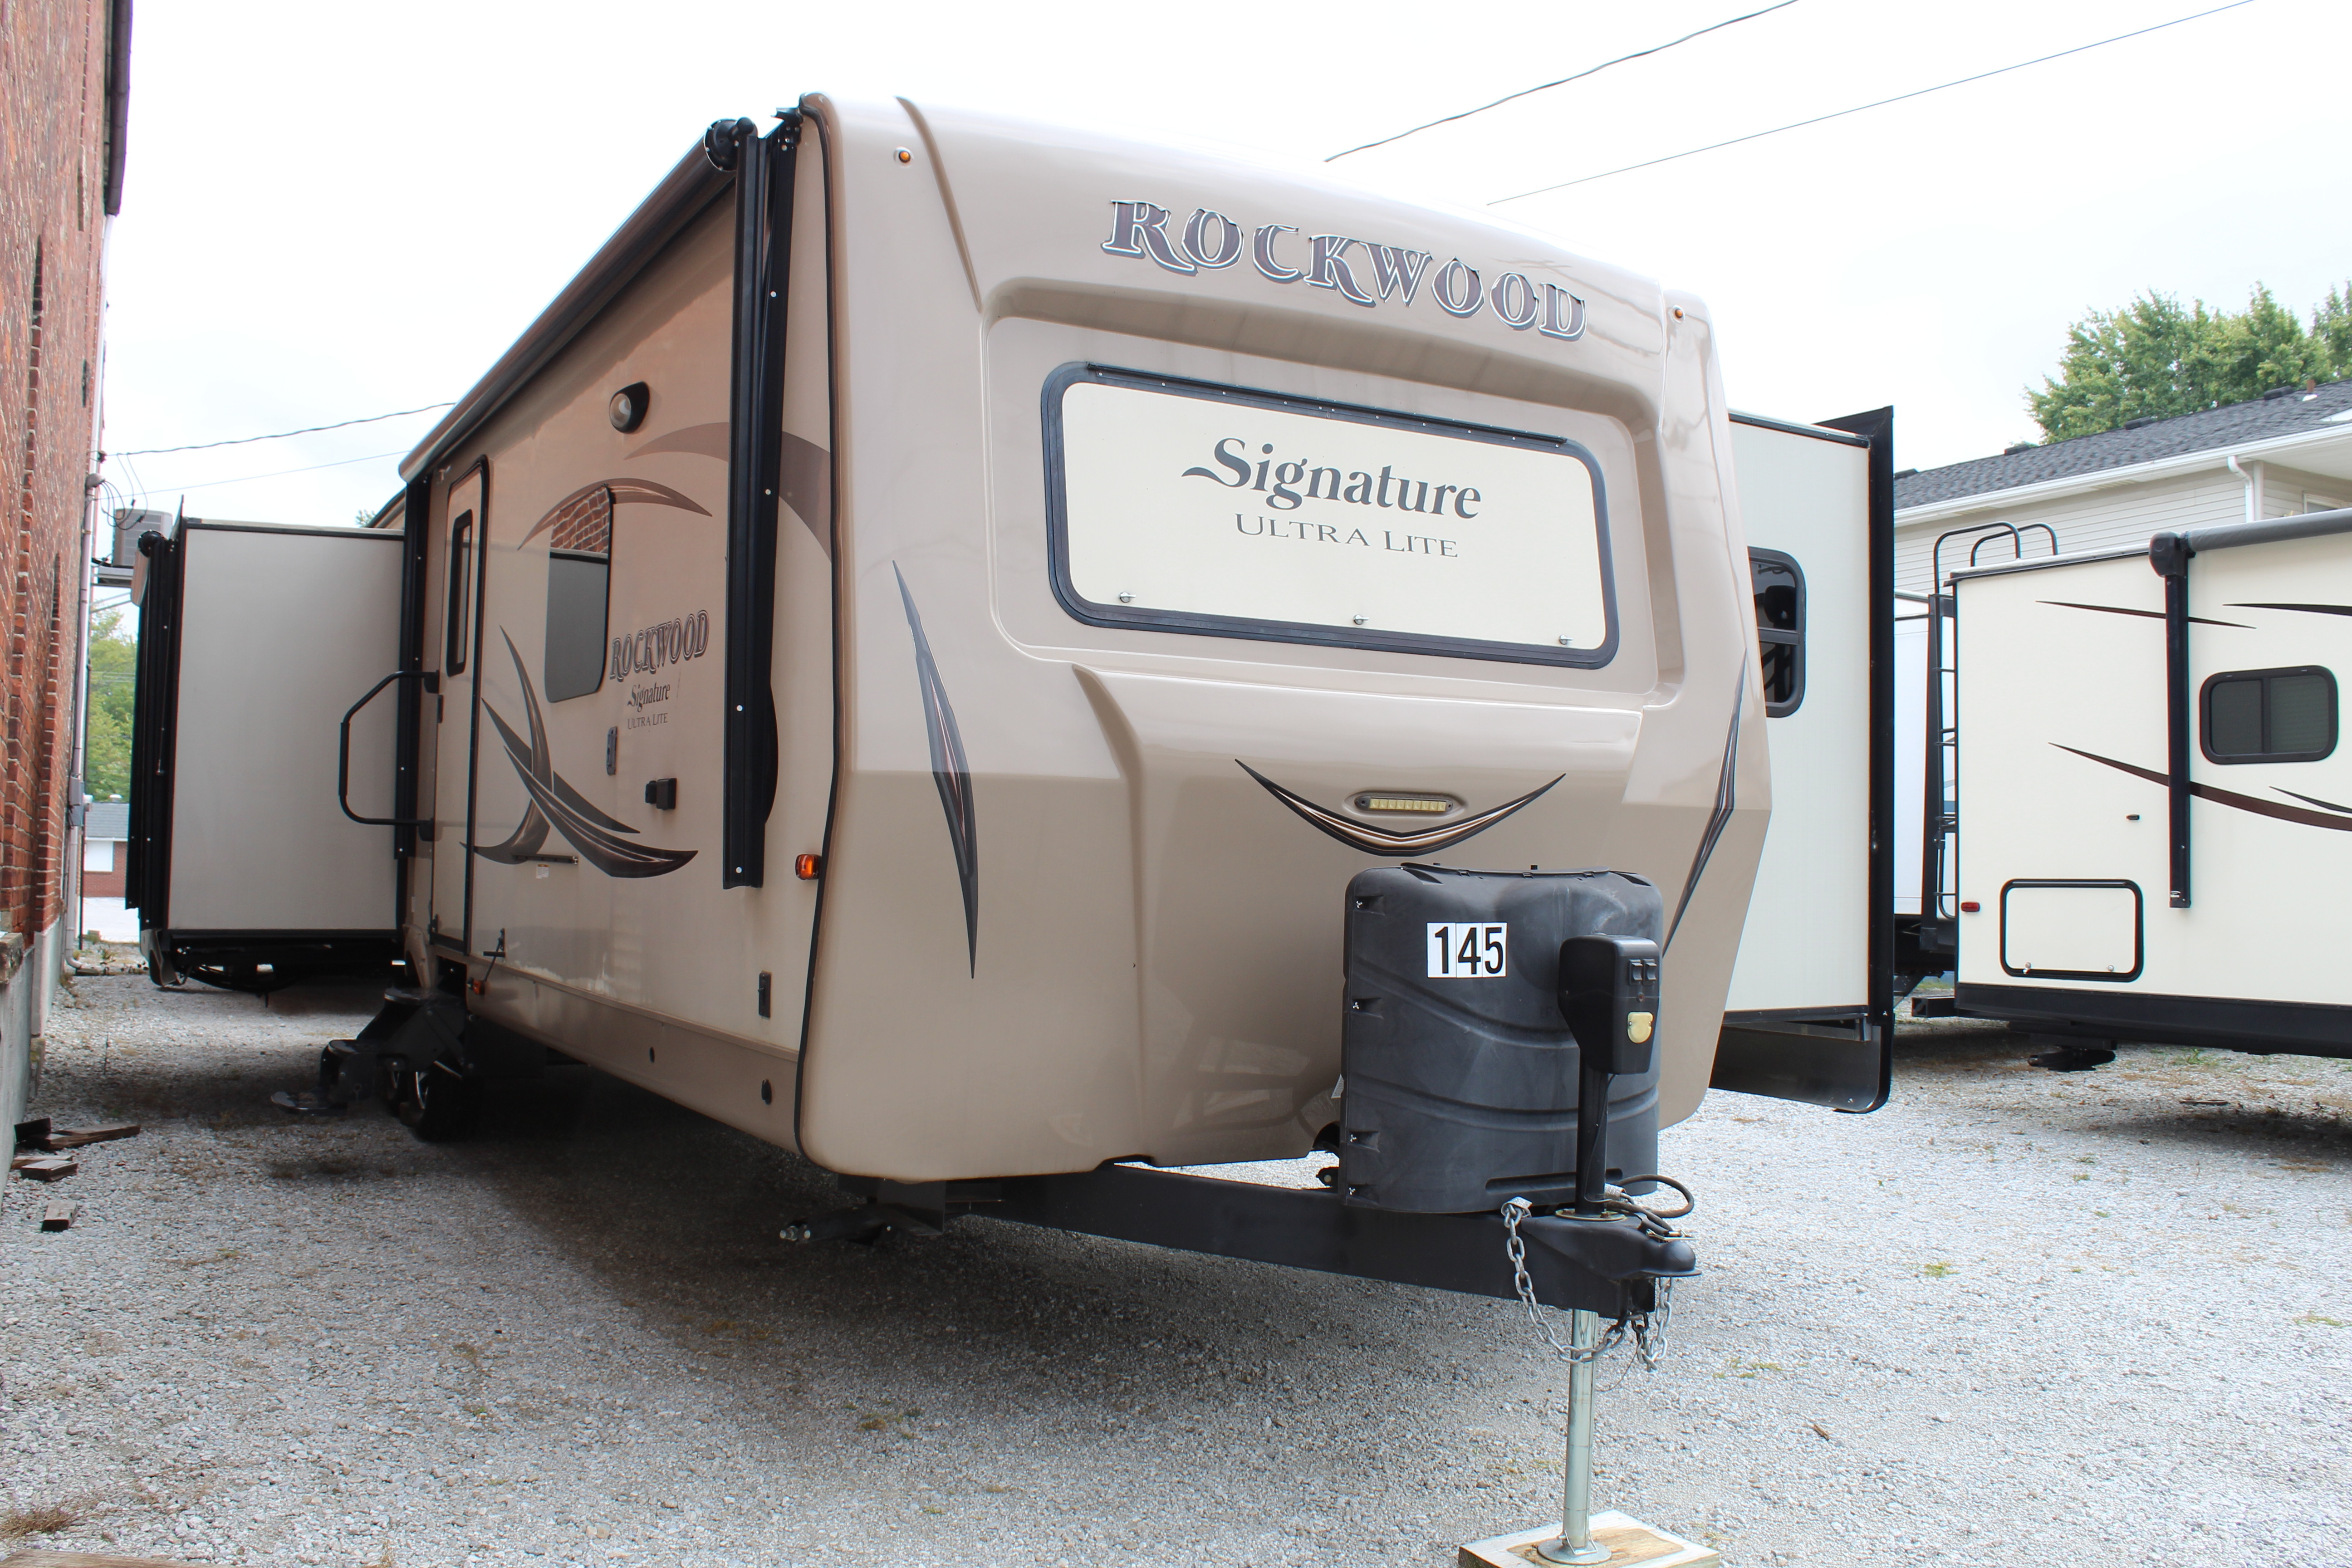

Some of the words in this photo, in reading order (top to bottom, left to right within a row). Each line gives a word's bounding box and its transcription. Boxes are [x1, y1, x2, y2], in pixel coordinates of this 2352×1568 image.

[1100, 200, 1587, 342] ROCKWOOD
[1181, 438, 1481, 519] Signature
[1235, 513, 1371, 547] ULTRA
[1383, 530, 1458, 558] LITE
[609, 609, 710, 682] ROCKWOOD
[627, 682, 671, 713] Signature
[627, 716, 651, 730] ULTRA
[652, 712, 668, 725] LITE
[1434, 926, 1504, 975] 145
